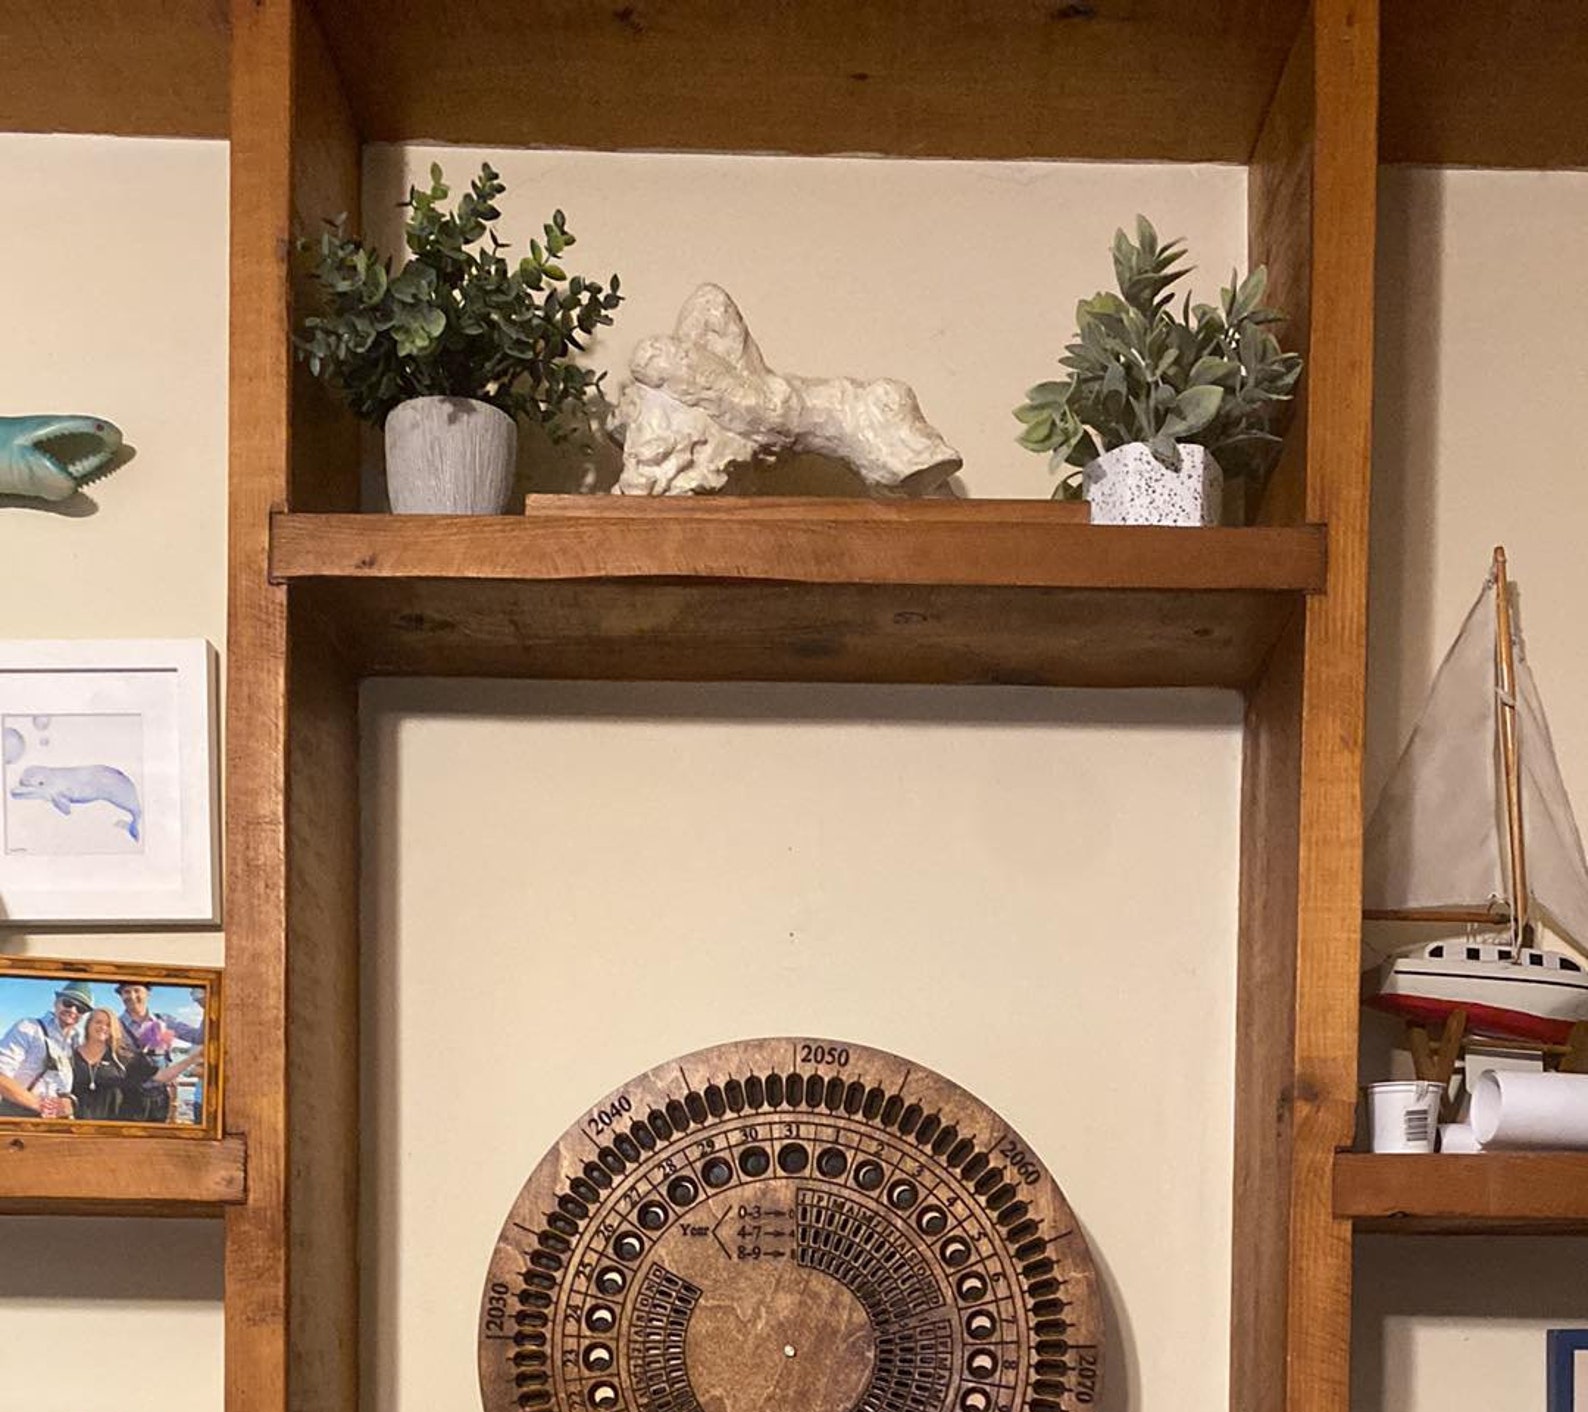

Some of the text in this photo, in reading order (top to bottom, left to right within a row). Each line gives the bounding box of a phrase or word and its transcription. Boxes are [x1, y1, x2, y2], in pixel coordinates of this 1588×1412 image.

[802, 1045, 849, 1067] 2050
[588, 1096, 631, 1135] 2040
[740, 1127, 758, 1143] 30
[784, 1124, 799, 1137] 31
[697, 1139, 715, 1157] 29
[873, 1142, 885, 1157] 2
[657, 1159, 677, 1179] 28
[1002, 1139, 1042, 1185] 2060
[911, 1165, 924, 1178] 3
[946, 1196, 959, 1207] 4
[738, 1205, 761, 1220] 0-3
[597, 1222, 615, 1243] 26
[680, 1223, 710, 1236] Year
[737, 1225, 761, 1241] 4-7
[971, 1231, 985, 1242] 5
[737, 1245, 761, 1260] 8-9
[577, 1261, 595, 1282] 25
[991, 1272, 1005, 1283] 6
[489, 1283, 509, 1331] 2030
[567, 1304, 582, 1324] 24
[1001, 1315, 1015, 1324] 7
[565, 1349, 578, 1367] 23
[1003, 1360, 1016, 1370] 8
[1075, 1355, 1096, 1403] 2070
